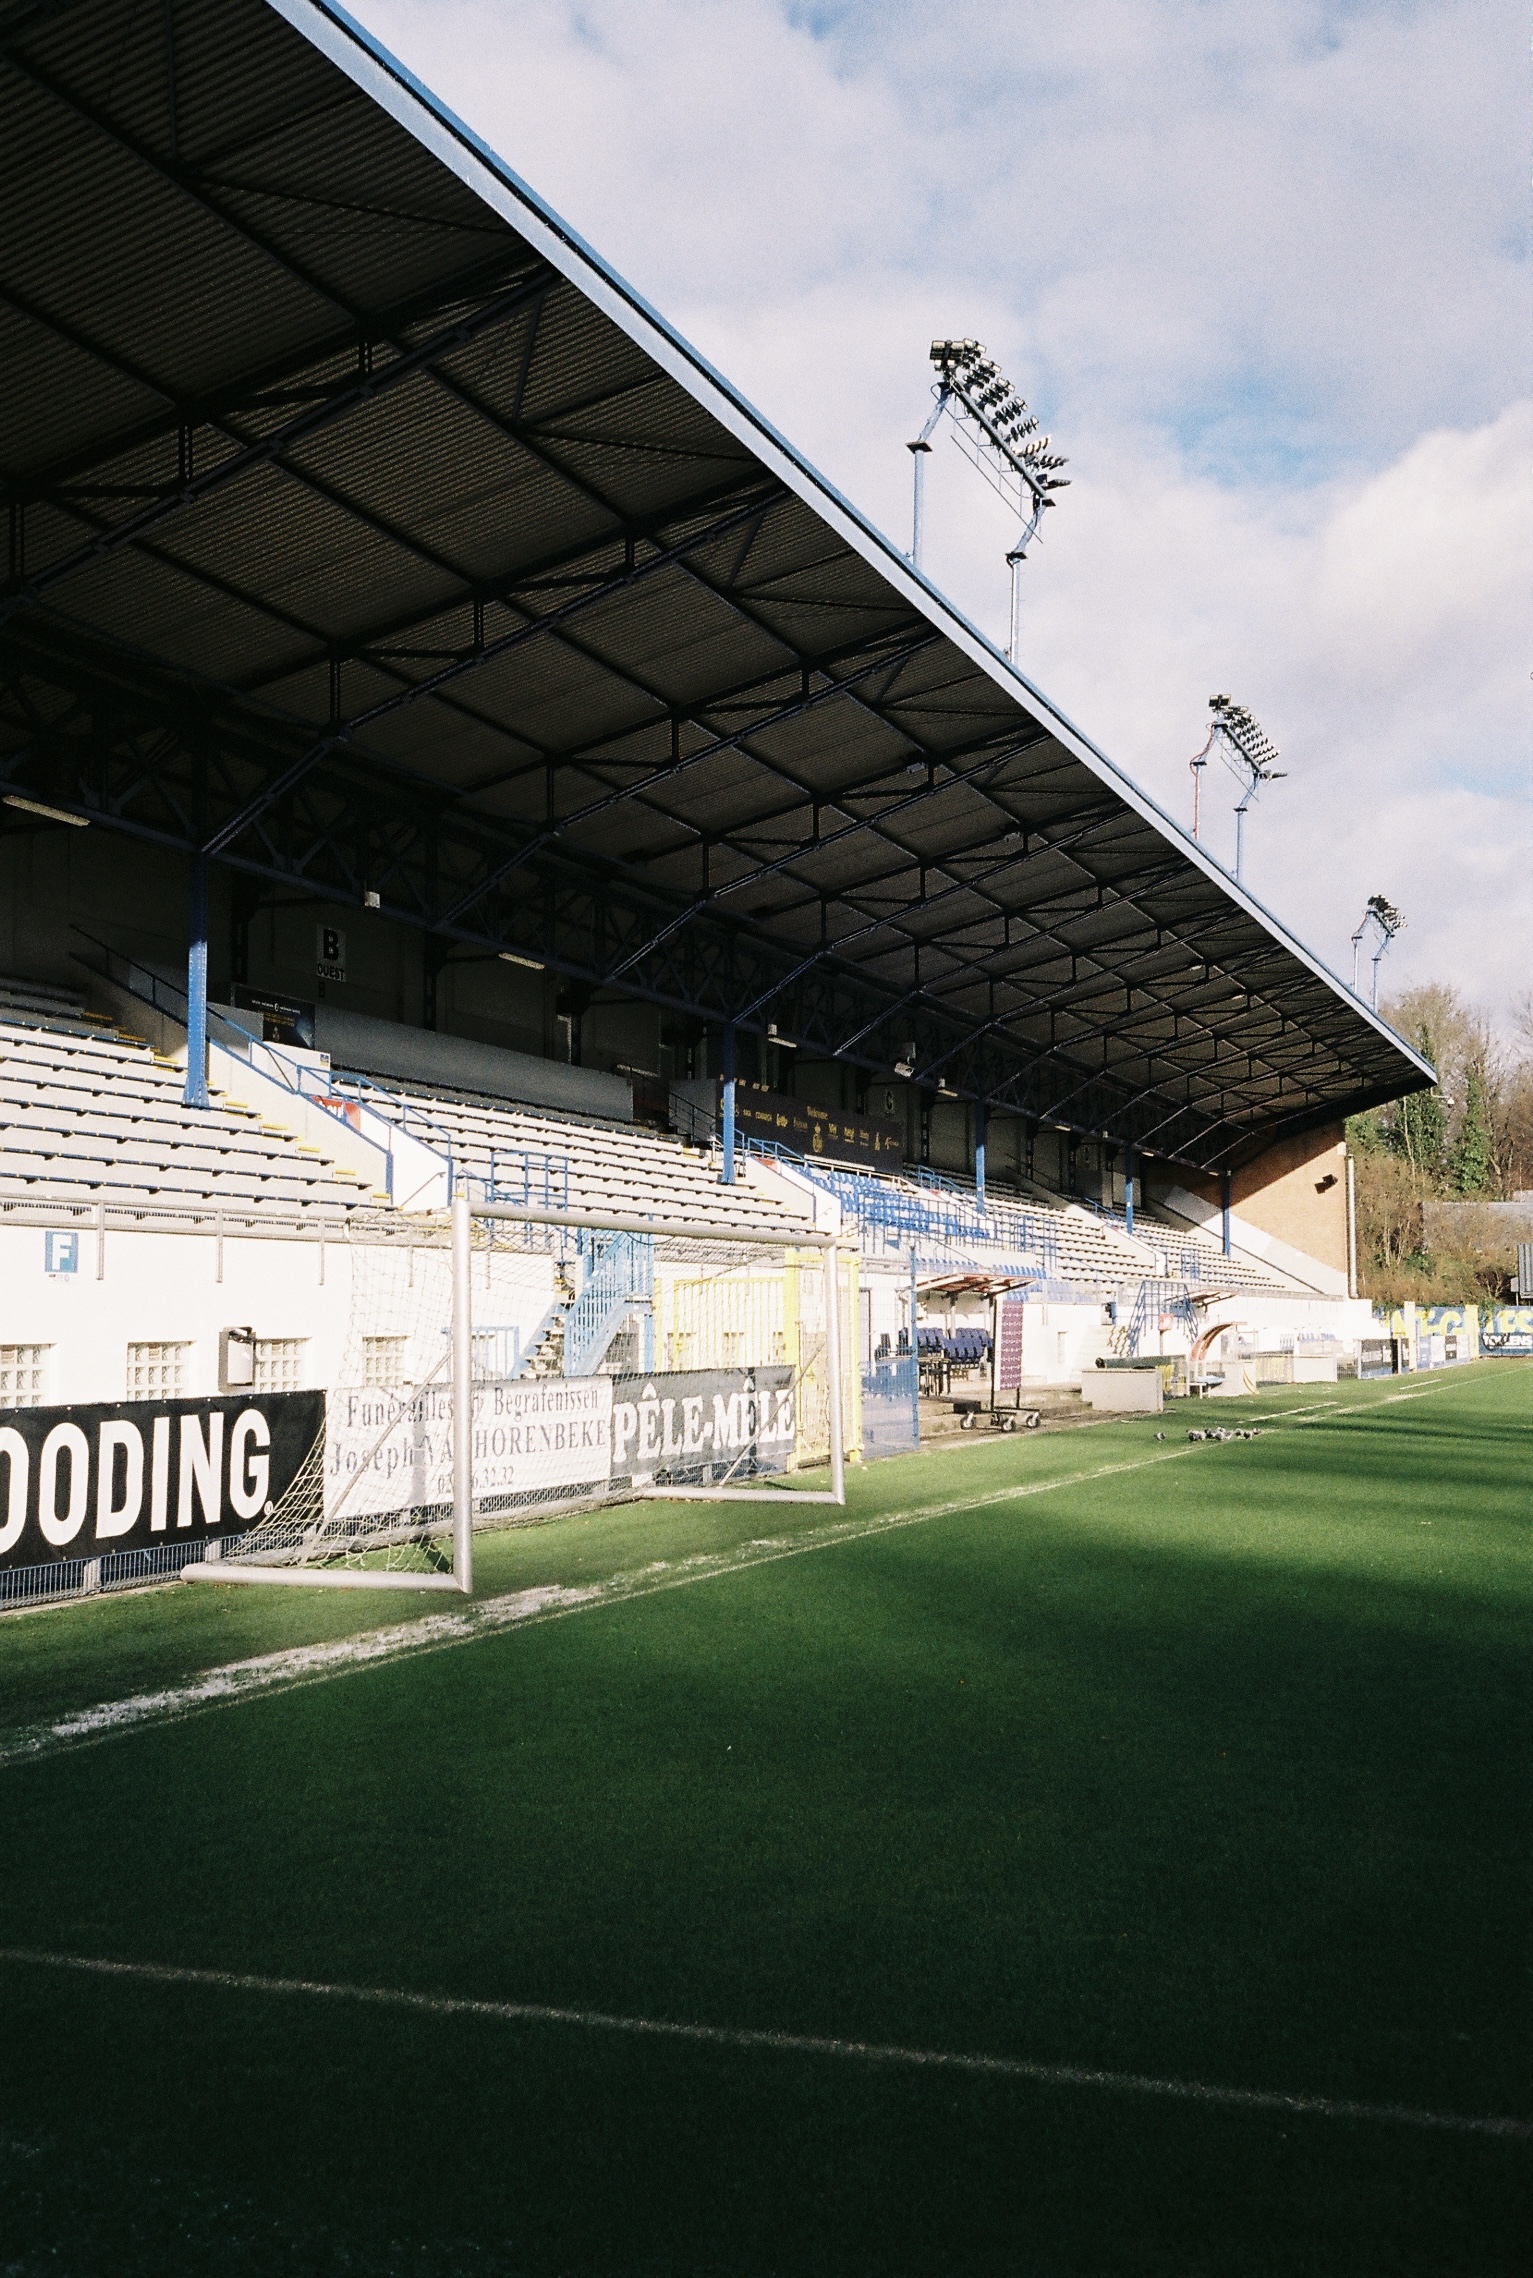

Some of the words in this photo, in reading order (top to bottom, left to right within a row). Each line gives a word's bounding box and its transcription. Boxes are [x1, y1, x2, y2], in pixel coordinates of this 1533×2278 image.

[323, 928, 339, 961] B
[317, 963, 345, 981] OUEST
[51, 1233, 71, 1271] F
[494, 1384, 599, 1422] Begrafenissen
[329, 1438, 415, 1479] Joseph
